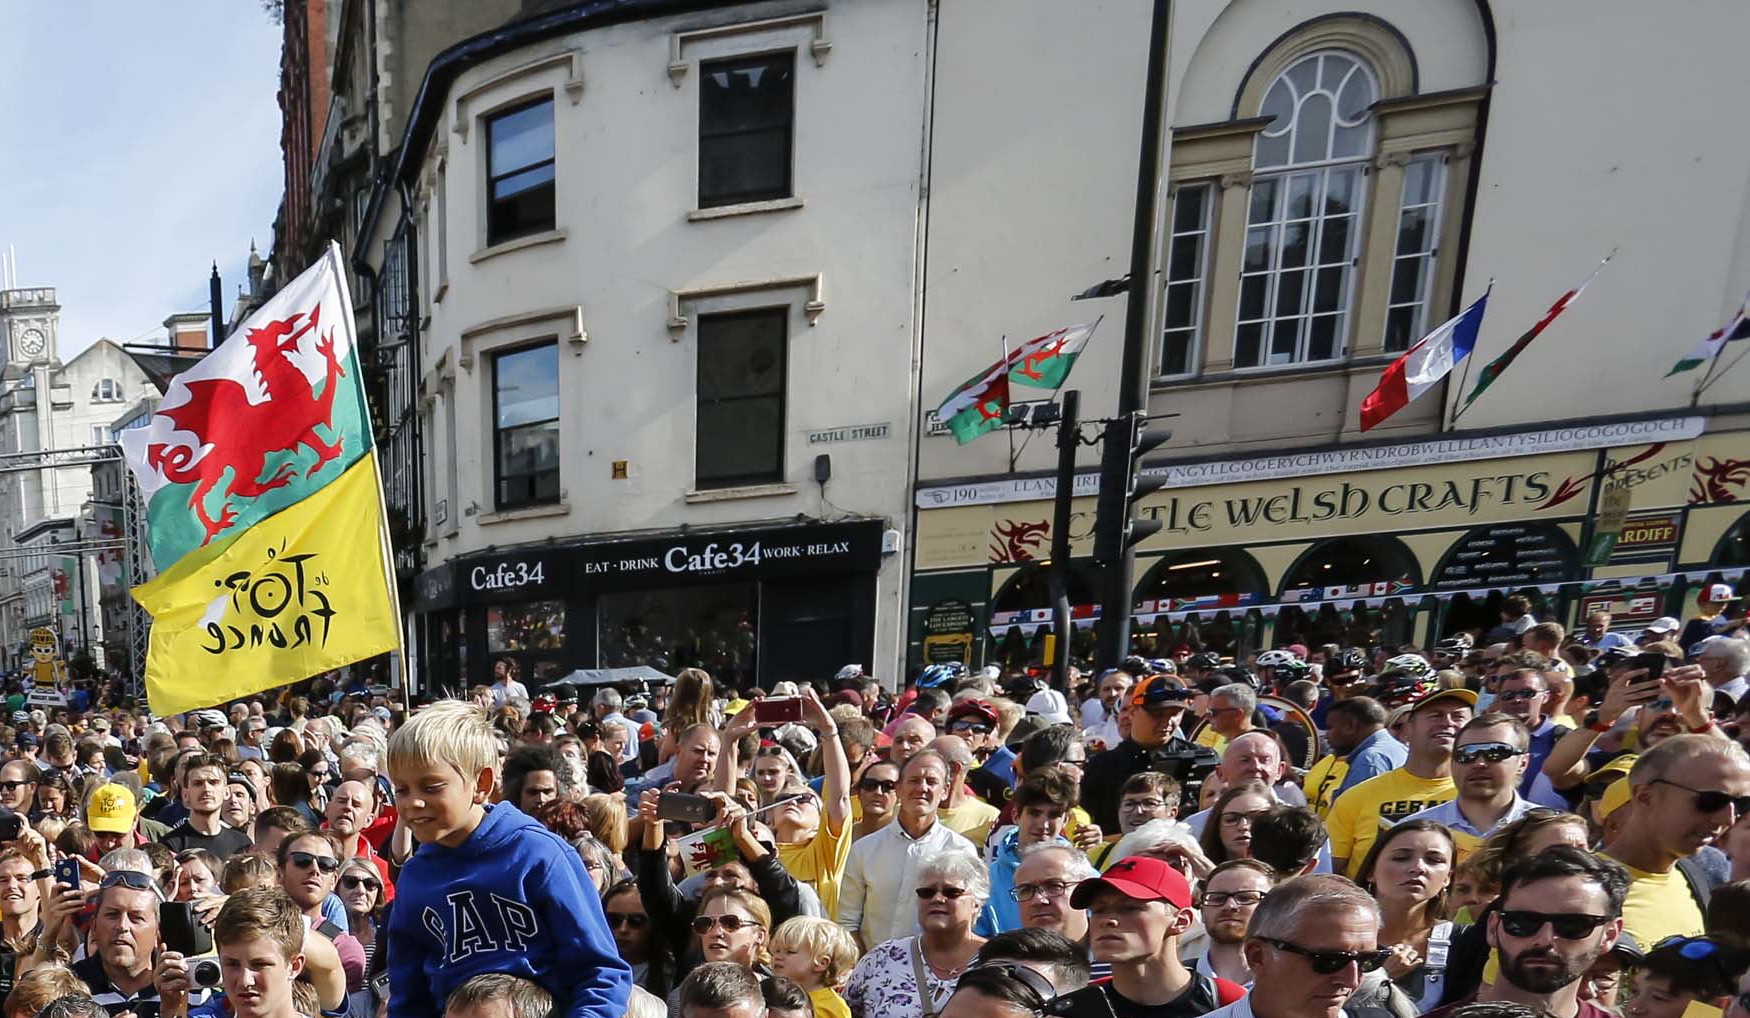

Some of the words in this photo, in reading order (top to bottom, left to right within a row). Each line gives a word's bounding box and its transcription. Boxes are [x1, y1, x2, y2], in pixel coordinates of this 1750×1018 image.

[809, 432, 844, 443] CASTLE
[851, 426, 888, 439] STREET
[954, 488, 977, 501] 190
[1069, 497, 1212, 541] CTLE
[1378, 471, 1551, 516] CRAFTS
[1618, 527, 1673, 543] RDIFF
[586, 562, 609, 573] EAT
[620, 558, 659, 571] DRINK
[664, 542, 761, 572] Cafe34
[763, 548, 800, 559] WORK
[808, 542, 849, 554] RELAX
[471, 561, 545, 590] Cafe34
